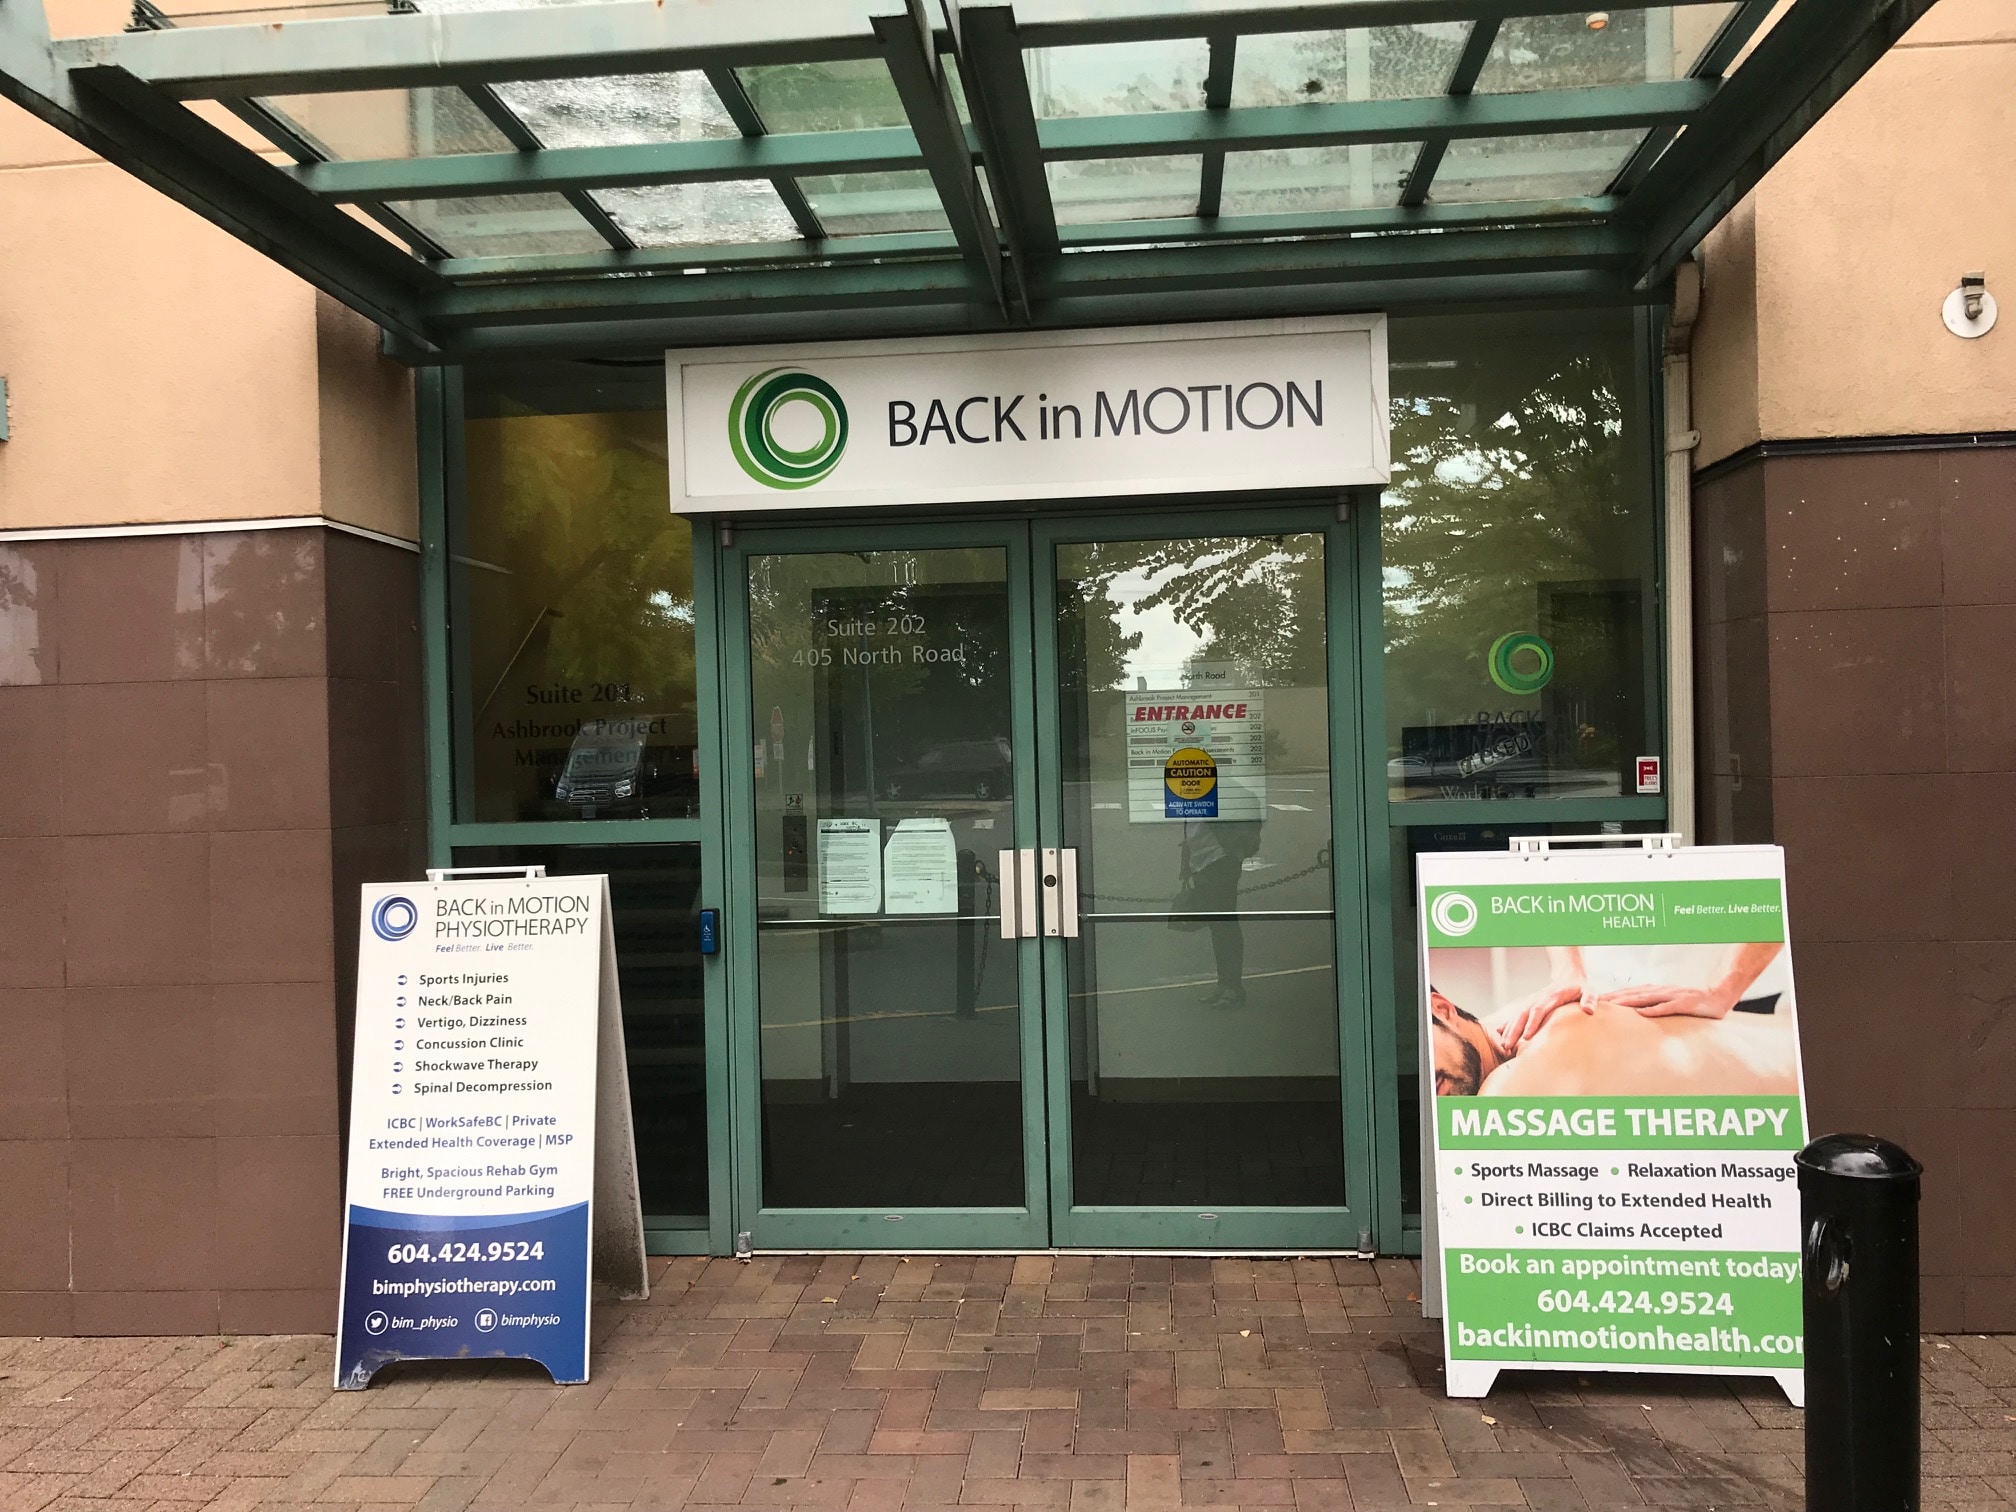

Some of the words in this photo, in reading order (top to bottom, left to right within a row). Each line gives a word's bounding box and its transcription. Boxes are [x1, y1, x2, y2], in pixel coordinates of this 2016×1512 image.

[888, 394, 1026, 447] BACK
[1039, 393, 1081, 442] in
[1094, 379, 1323, 437] MOTION
[828, 618, 876, 638] Suite
[887, 616, 926, 636] 202
[791, 648, 832, 667] 405
[843, 645, 902, 666] North
[912, 643, 965, 663] Road
[526, 683, 583, 705] Suite
[1129, 694, 1156, 702] Ashbrook
[1156, 694, 1175, 702] Project
[1176, 693, 1212, 701] Management
[1134, 703, 1247, 722] ENTRANCE
[1477, 710, 1542, 732] BACK
[492, 718, 588, 740] Ashbrook
[595, 717, 667, 740] Project
[1251, 756, 1263, 764] 202
[1170, 768, 1211, 777] CAUTION
[1184, 808, 1207, 816] OPERATE
[1194, 800, 1214, 808] SWITCH
[436, 898, 487, 917] BACK
[490, 900, 504, 915] in
[507, 895, 590, 914] MOTION
[1491, 894, 1544, 915] BACK
[1548, 894, 1565, 913] in
[1569, 893, 1655, 912] MOTION
[1674, 904, 1695, 915] Feel
[1696, 903, 1727, 915] Better.
[1728, 903, 1749, 914] Live
[1750, 902, 1782, 914] Better.
[435, 917, 589, 938] PHYSIOTHERAPY
[1602, 915, 1656, 929] HEALTH
[435, 943, 454, 953] Feel
[455, 943, 482, 953] Better.
[485, 942, 504, 952] Live
[507, 942, 534, 952] Better.
[419, 973, 459, 987] Sports
[462, 972, 509, 986] Injuries
[418, 995, 483, 1007] Neck/Back
[486, 994, 513, 1005] Pain
[417, 1017, 466, 1030] Vertigo,
[469, 1015, 528, 1027] Dizziness
[416, 1038, 486, 1050] Concussion
[489, 1037, 524, 1049] Clinic
[415, 1060, 485, 1072] Shockwave
[487, 1058, 539, 1072] Therapy
[414, 1081, 453, 1095] Spinal
[456, 1080, 553, 1094] Decompression
[387, 1117, 416, 1129] ICBC
[425, 1115, 503, 1129] WorkSafeBC
[512, 1114, 557, 1127] Private
[1451, 1108, 1617, 1137] MASSAGE
[1625, 1108, 1790, 1137] THERAPY
[369, 1138, 429, 1150] Extended
[432, 1137, 473, 1148] Health
[476, 1136, 536, 1150] Coverage
[545, 1134, 573, 1146] MSP
[381, 1166, 423, 1180] Bright,
[427, 1166, 483, 1180] Spacious
[486, 1165, 526, 1177] Rehab
[529, 1164, 558, 1178] Gym
[1470, 1162, 1524, 1180] Sports
[1527, 1163, 1599, 1181] Massage
[1627, 1162, 1717, 1178] Relaxation
[1720, 1163, 1796, 1182] Massage
[382, 1187, 414, 1199] FREE
[417, 1186, 502, 1200] Underground
[505, 1184, 555, 1199] Parking
[1480, 1192, 1533, 1208] Direct
[1538, 1192, 1593, 1211] Billing
[1598, 1194, 1616, 1208] to
[1621, 1193, 1706, 1209] Extended
[1710, 1193, 1772, 1209] Health
[1531, 1222, 1572, 1238] ICBC
[1576, 1222, 1635, 1239] Claims
[1639, 1223, 1723, 1242] Accepted
[387, 1241, 545, 1264] 604.424.9524
[1460, 1254, 1520, 1275] Book
[1526, 1258, 1555, 1275] an
[1561, 1256, 1721, 1280] appointment
[372, 1277, 556, 1299] bimphysiotherapy.com
[1537, 1289, 1734, 1317] 604.424.9524
[391, 1314, 458, 1332] bim_physio
[501, 1312, 561, 1330] bimphysio
